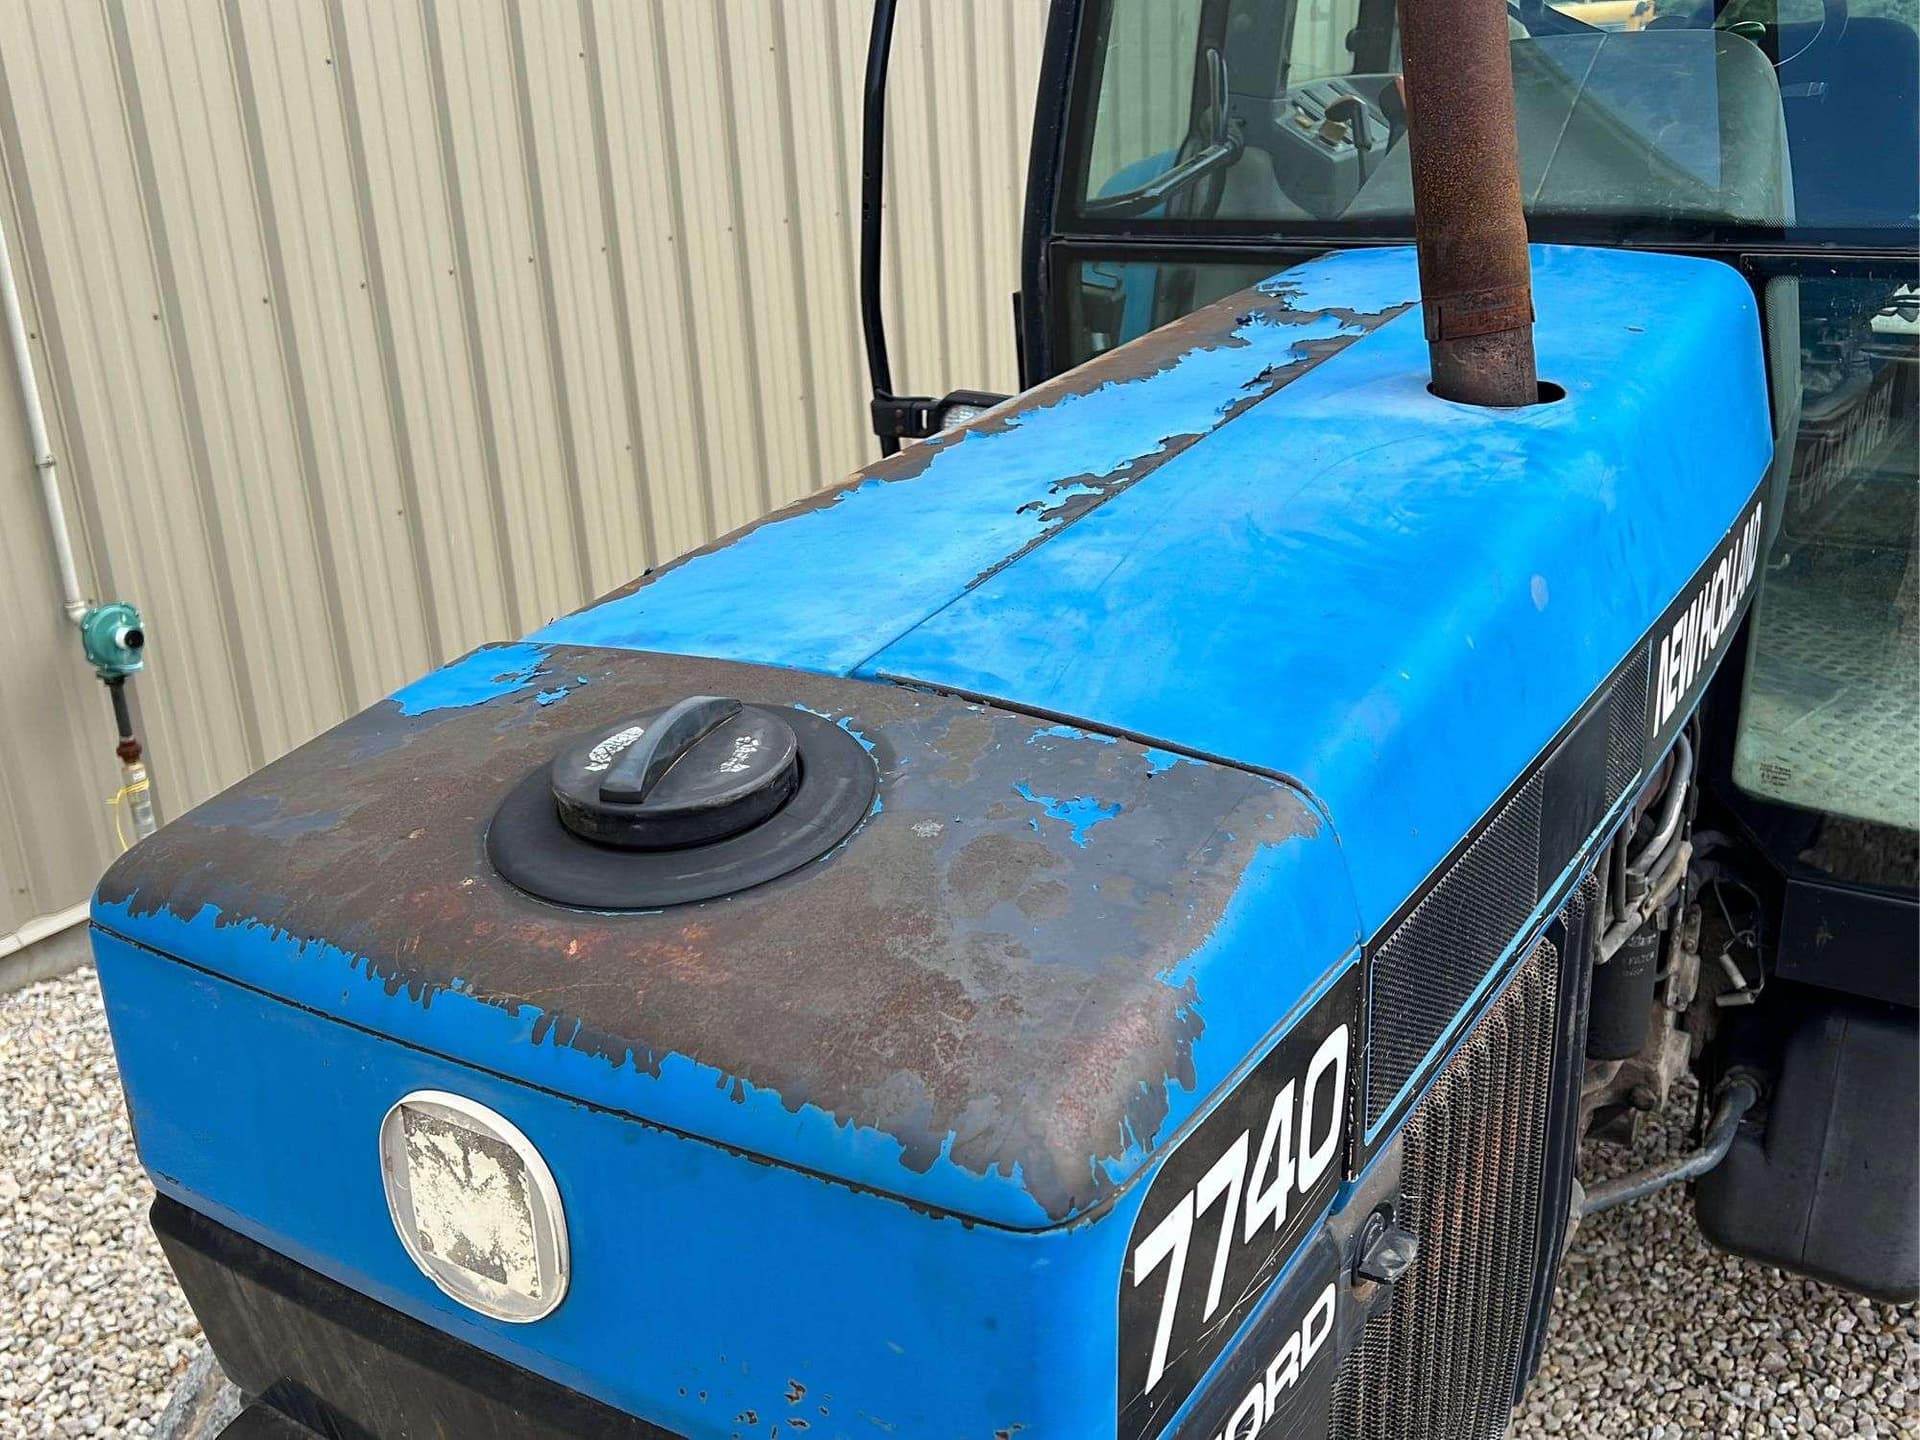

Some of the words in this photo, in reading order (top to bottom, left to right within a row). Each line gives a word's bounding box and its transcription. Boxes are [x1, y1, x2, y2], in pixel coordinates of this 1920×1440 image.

[1653, 590, 1703, 738] NEW
[1697, 501, 1762, 673] HOLLAND
[1134, 1023, 1349, 1395] 7740
[1214, 1283, 1337, 1440] ORD
